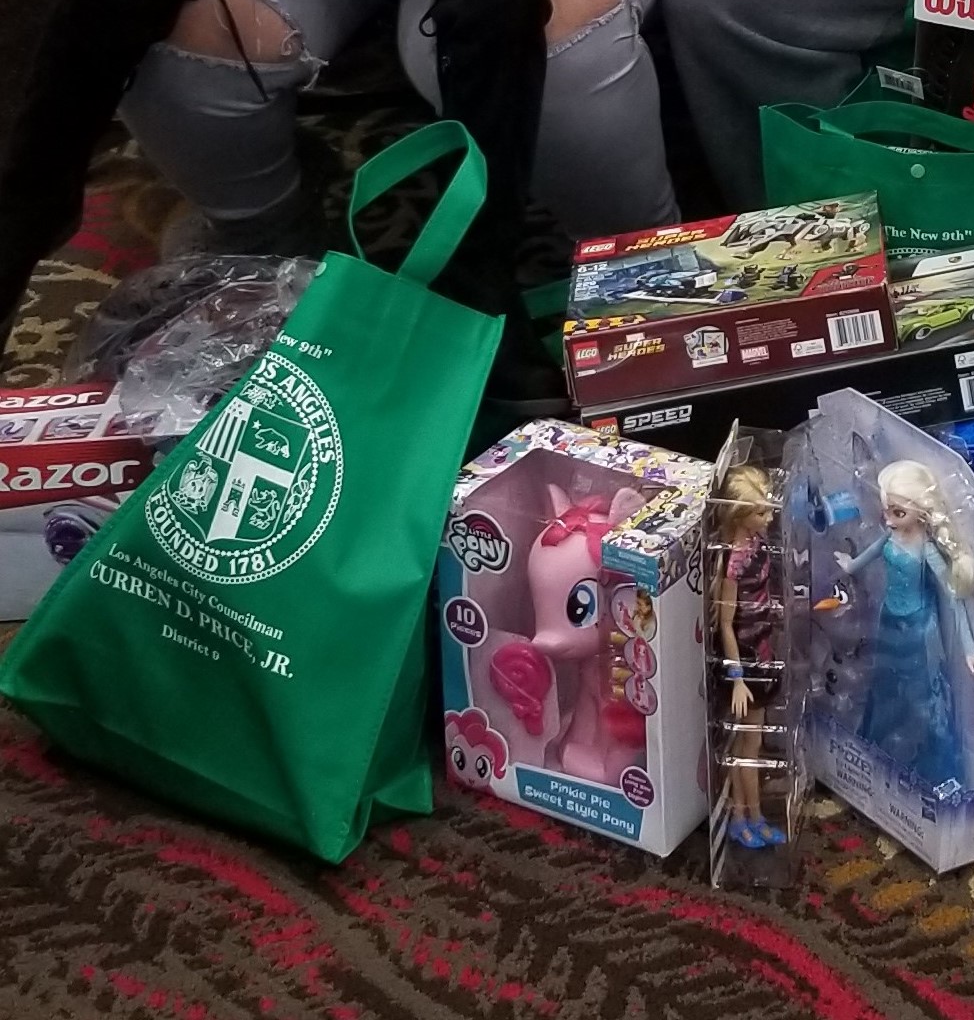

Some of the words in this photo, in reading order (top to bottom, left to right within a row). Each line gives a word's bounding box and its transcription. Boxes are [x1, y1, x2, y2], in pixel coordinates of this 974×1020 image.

[910, 228, 938, 240] New
[575, 347, 597, 360] LEGO
[0, 392, 103, 408] azor
[278, 374, 336, 464] ANGELES
[623, 405, 693, 430] SPEED
[150, 492, 219, 572] FOUNDED
[229, 548, 276, 576] 1781
[108, 543, 131, 563] Los
[133, 556, 179, 588] Angeles
[181, 580, 207, 604] City
[208, 595, 284, 640] Councilman
[90, 559, 172, 608] CURREN
[176, 599, 194, 622] D.
[199, 610, 256, 664] PRICE,
[260, 650, 294, 678] JR.
[456, 605, 476, 626] 10
[161, 624, 210, 657] District
[524, 785, 563, 808] Sweet
[566, 800, 598, 818] Style
[602, 813, 635, 835] Pony
[550, 780, 586, 800] Pinkie
[590, 794, 611, 809] Pie
